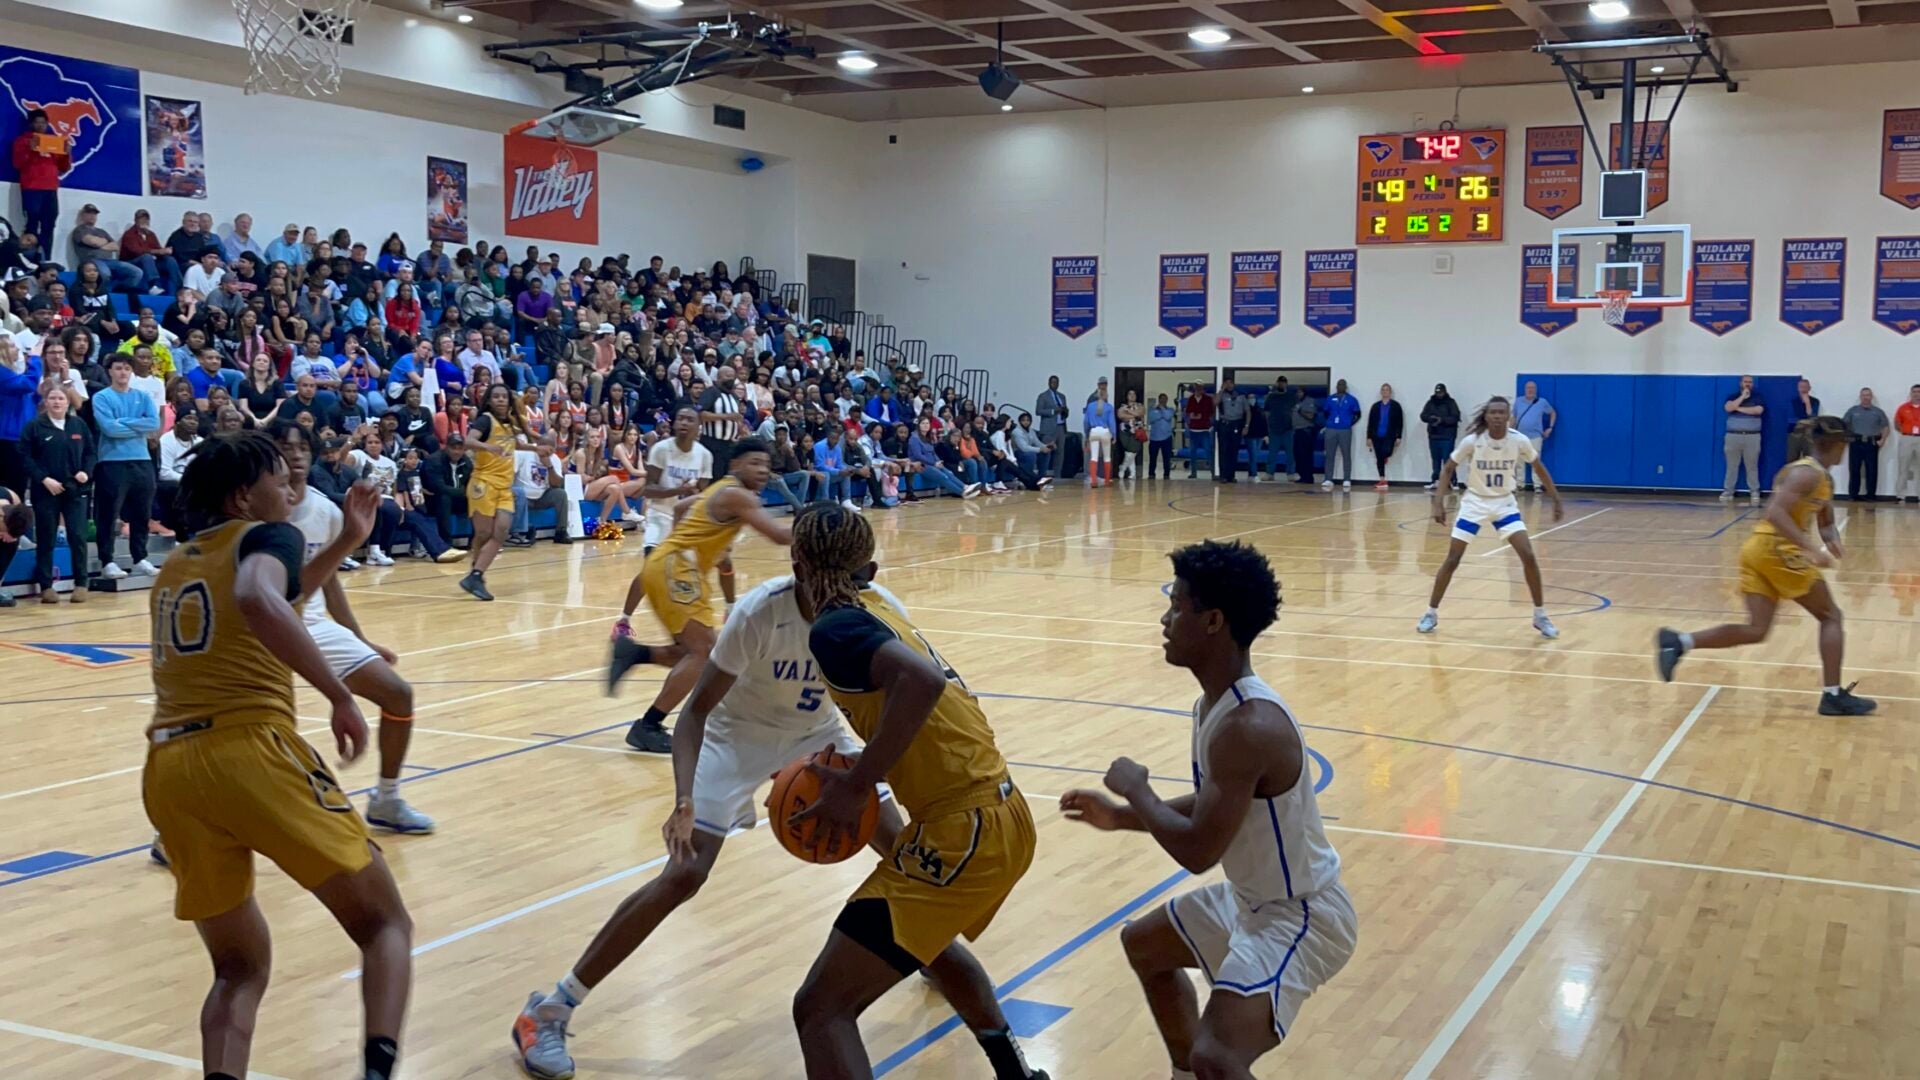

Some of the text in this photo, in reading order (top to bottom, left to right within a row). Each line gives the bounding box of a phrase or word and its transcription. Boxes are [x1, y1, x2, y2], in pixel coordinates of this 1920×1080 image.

[1416, 136, 1461, 159] 7:42
[1371, 168, 1408, 178] GUEST
[1424, 174, 1436, 191] 4
[510, 164, 594, 220] Valley
[1377, 179, 1405, 202] 49
[1460, 176, 1488, 200] 26
[1375, 217, 1387, 234] 2
[1407, 214, 1451, 232] 05 2
[1476, 213, 1489, 231] 3
[1696, 244, 1751, 254] MIDLAND
[1786, 241, 1843, 251] MIDLAND
[1525, 247, 1576, 257] MIDLND
[1700, 252, 1745, 262] VALLEY
[1791, 250, 1837, 260] VALLEY
[1162, 257, 1206, 266] MIDLAND
[1234, 254, 1279, 263] MIDLAND
[1308, 253, 1355, 262] MIDLAND
[1055, 259, 1096, 268] MIDLAND
[1237, 262, 1274, 271] VALLEY
[1312, 261, 1350, 270] VALLEY
[1058, 267, 1092, 275] VALLEY
[1166, 265, 1202, 274] VALLEY
[1476, 459, 1515, 470] VALLEY
[1485, 473, 1504, 488] 10
[153, 578, 216, 669] 10
[796, 687, 826, 713] 5
